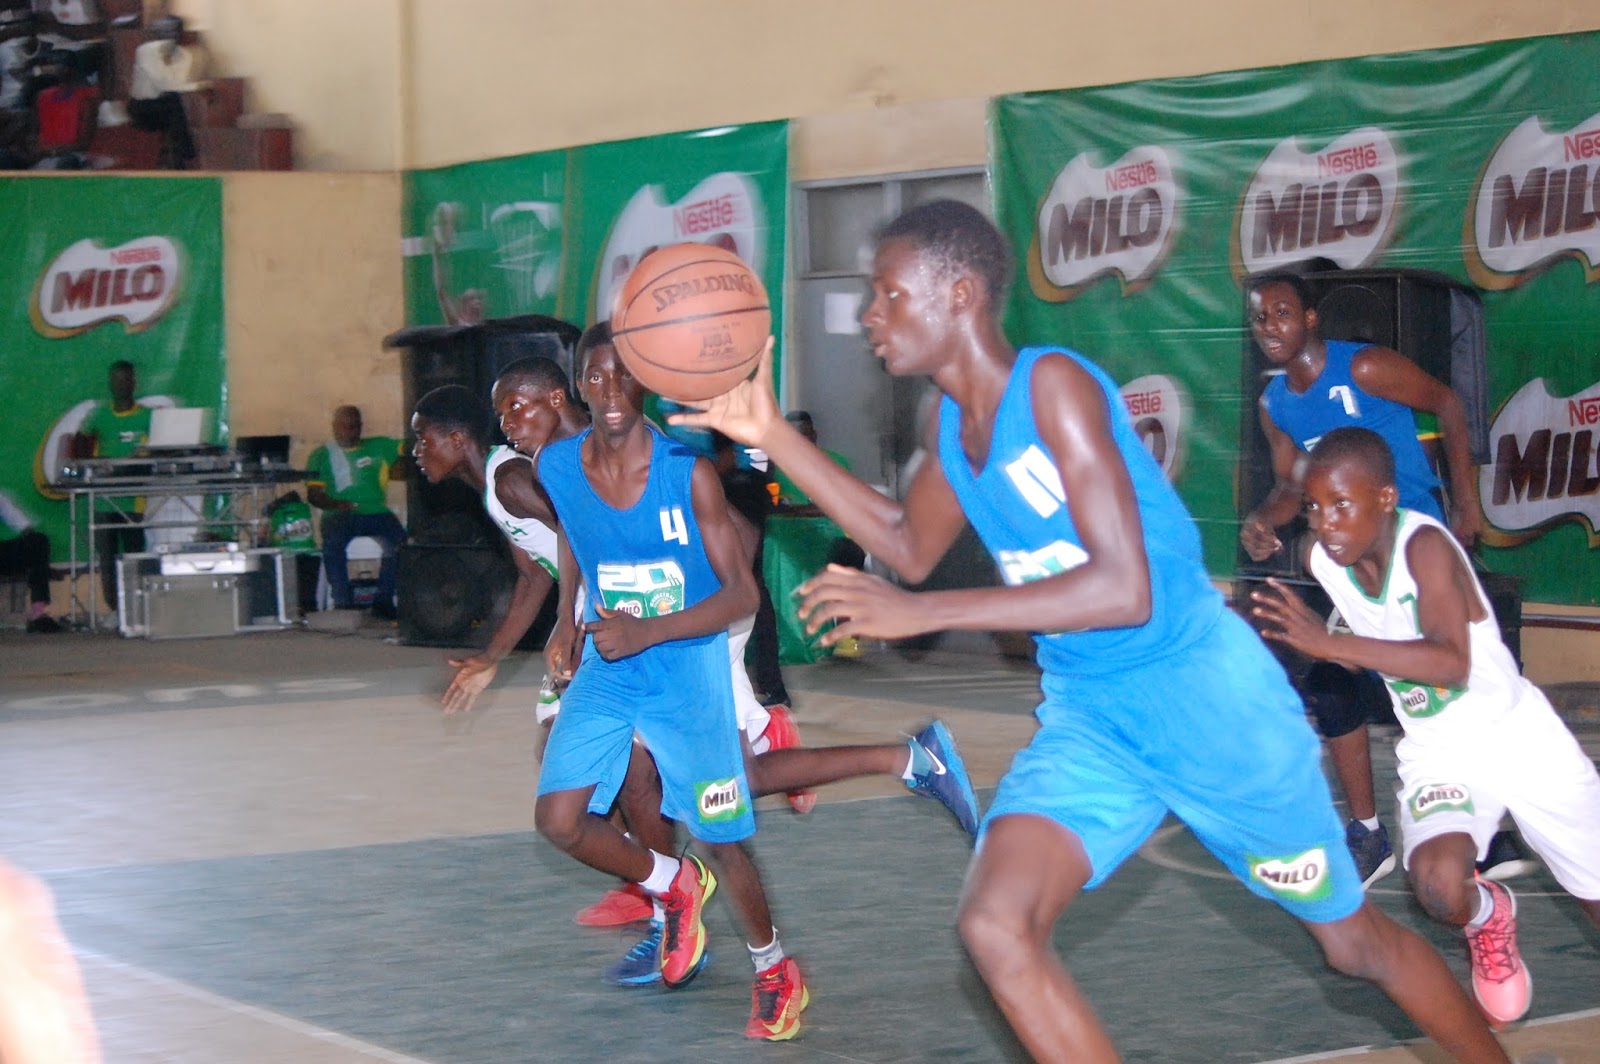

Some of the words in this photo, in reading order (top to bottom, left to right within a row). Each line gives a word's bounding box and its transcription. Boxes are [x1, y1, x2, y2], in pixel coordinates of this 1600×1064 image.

[1564, 129, 1600, 162] Nes
[1252, 173, 1383, 258] MILO
[1488, 164, 1600, 248] MIL
[1047, 188, 1162, 266] MILO
[51, 264, 165, 314] MILO
[652, 274, 758, 312] SPALDING
[1122, 389, 1162, 416] stlé
[1492, 429, 1600, 506] MIL
[659, 508, 689, 545] 4
[1418, 789, 1464, 808] MILO
[1260, 862, 1318, 884] MILO
